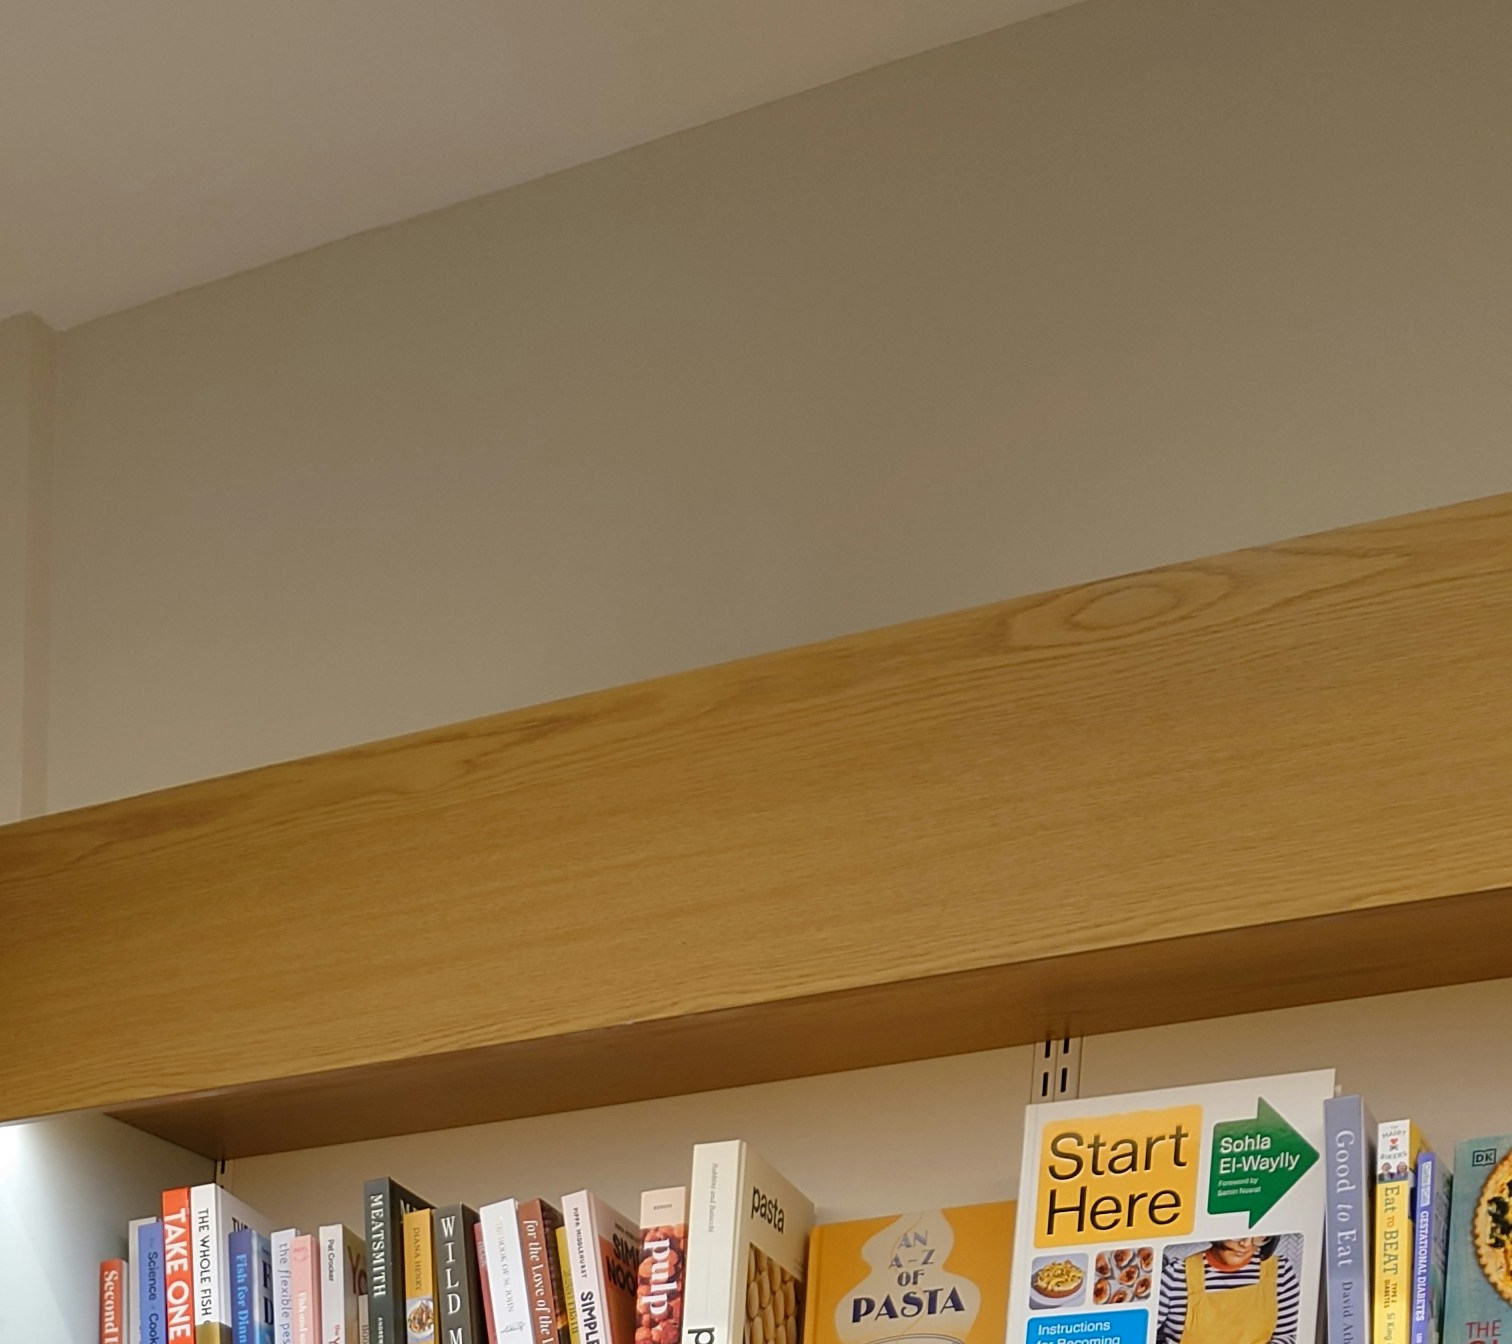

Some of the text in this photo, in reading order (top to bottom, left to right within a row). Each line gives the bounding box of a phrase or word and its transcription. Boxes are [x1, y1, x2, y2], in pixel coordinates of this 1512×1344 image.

[1048, 1125, 1189, 1181] Start
[1219, 1133, 1271, 1155] Sohla
[1219, 1153, 1300, 1174] El-Waylly
[1048, 1187, 1182, 1234] Here
[1335, 1130, 1356, 1267] Good to Eat
[165, 1208, 189, 1272] TAKE
[370, 1194, 386, 1298] MEATSMITH
[441, 1216, 461, 1315] WILD
[899, 1231, 928, 1249] AN
[643, 1238, 671, 1317] pulp
[897, 1270, 925, 1287] OF
[168, 1279, 189, 1337] ONE
[851, 1289, 965, 1324] PASTA
[1037, 1319, 1111, 1336] Instructions
